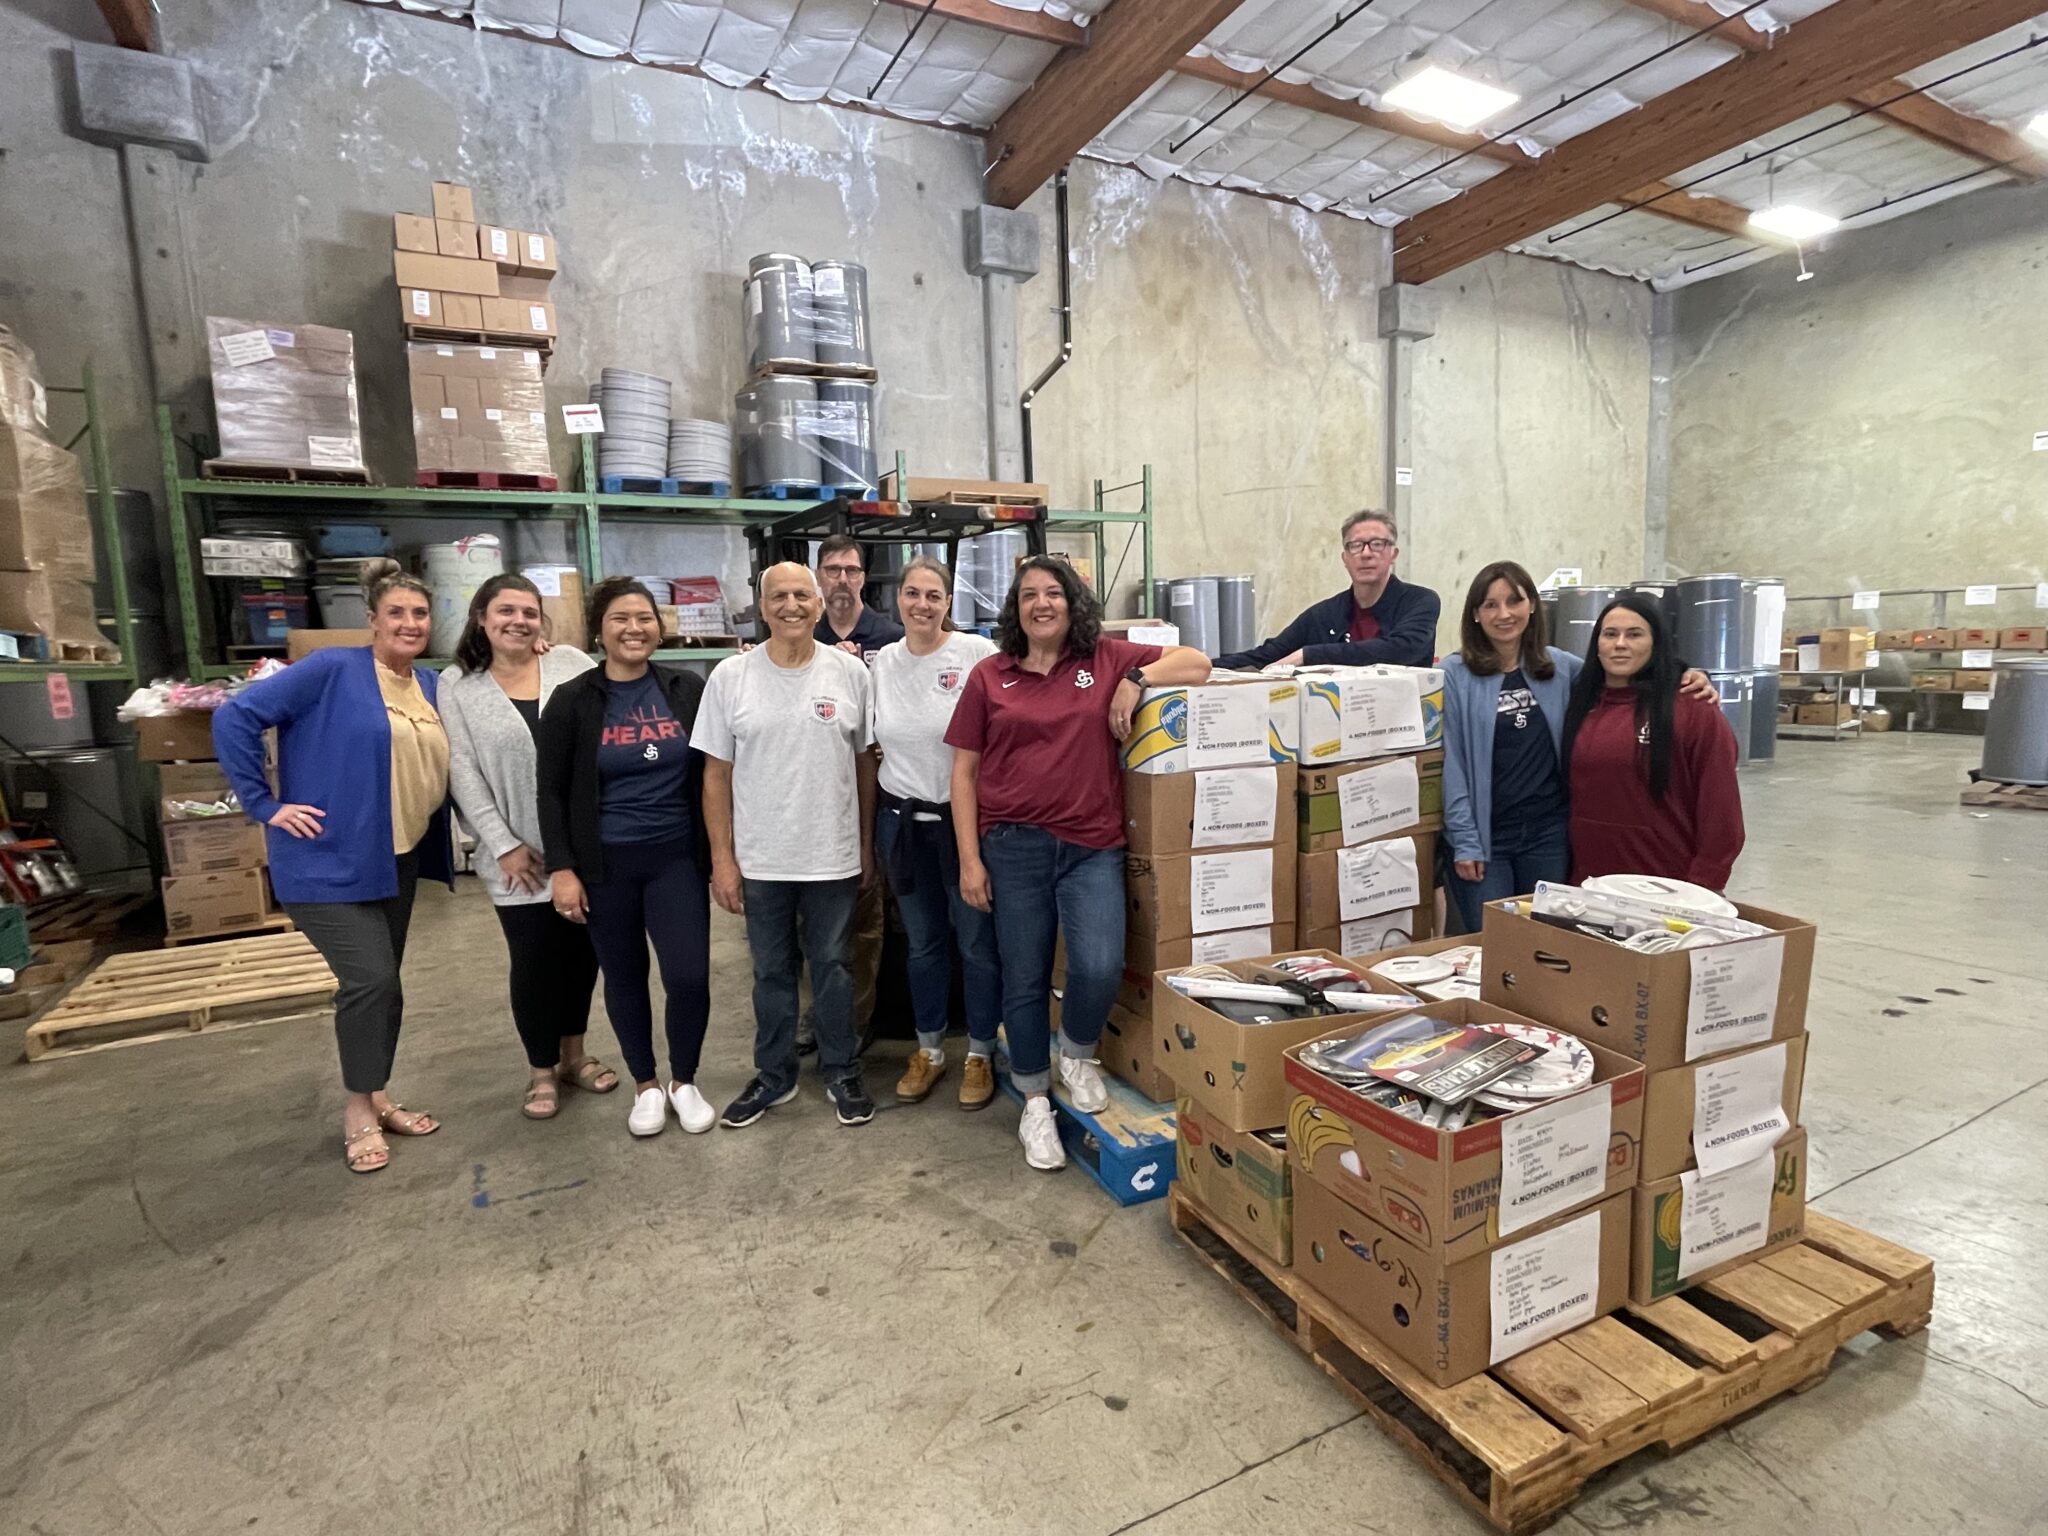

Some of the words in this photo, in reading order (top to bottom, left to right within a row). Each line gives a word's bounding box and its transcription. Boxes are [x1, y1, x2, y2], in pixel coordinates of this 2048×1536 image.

[1423, 1067, 1469, 1096] CARS
[1452, 1176, 1501, 1204] ANANAS
[1557, 1292, 1589, 1313] (BOXED)
